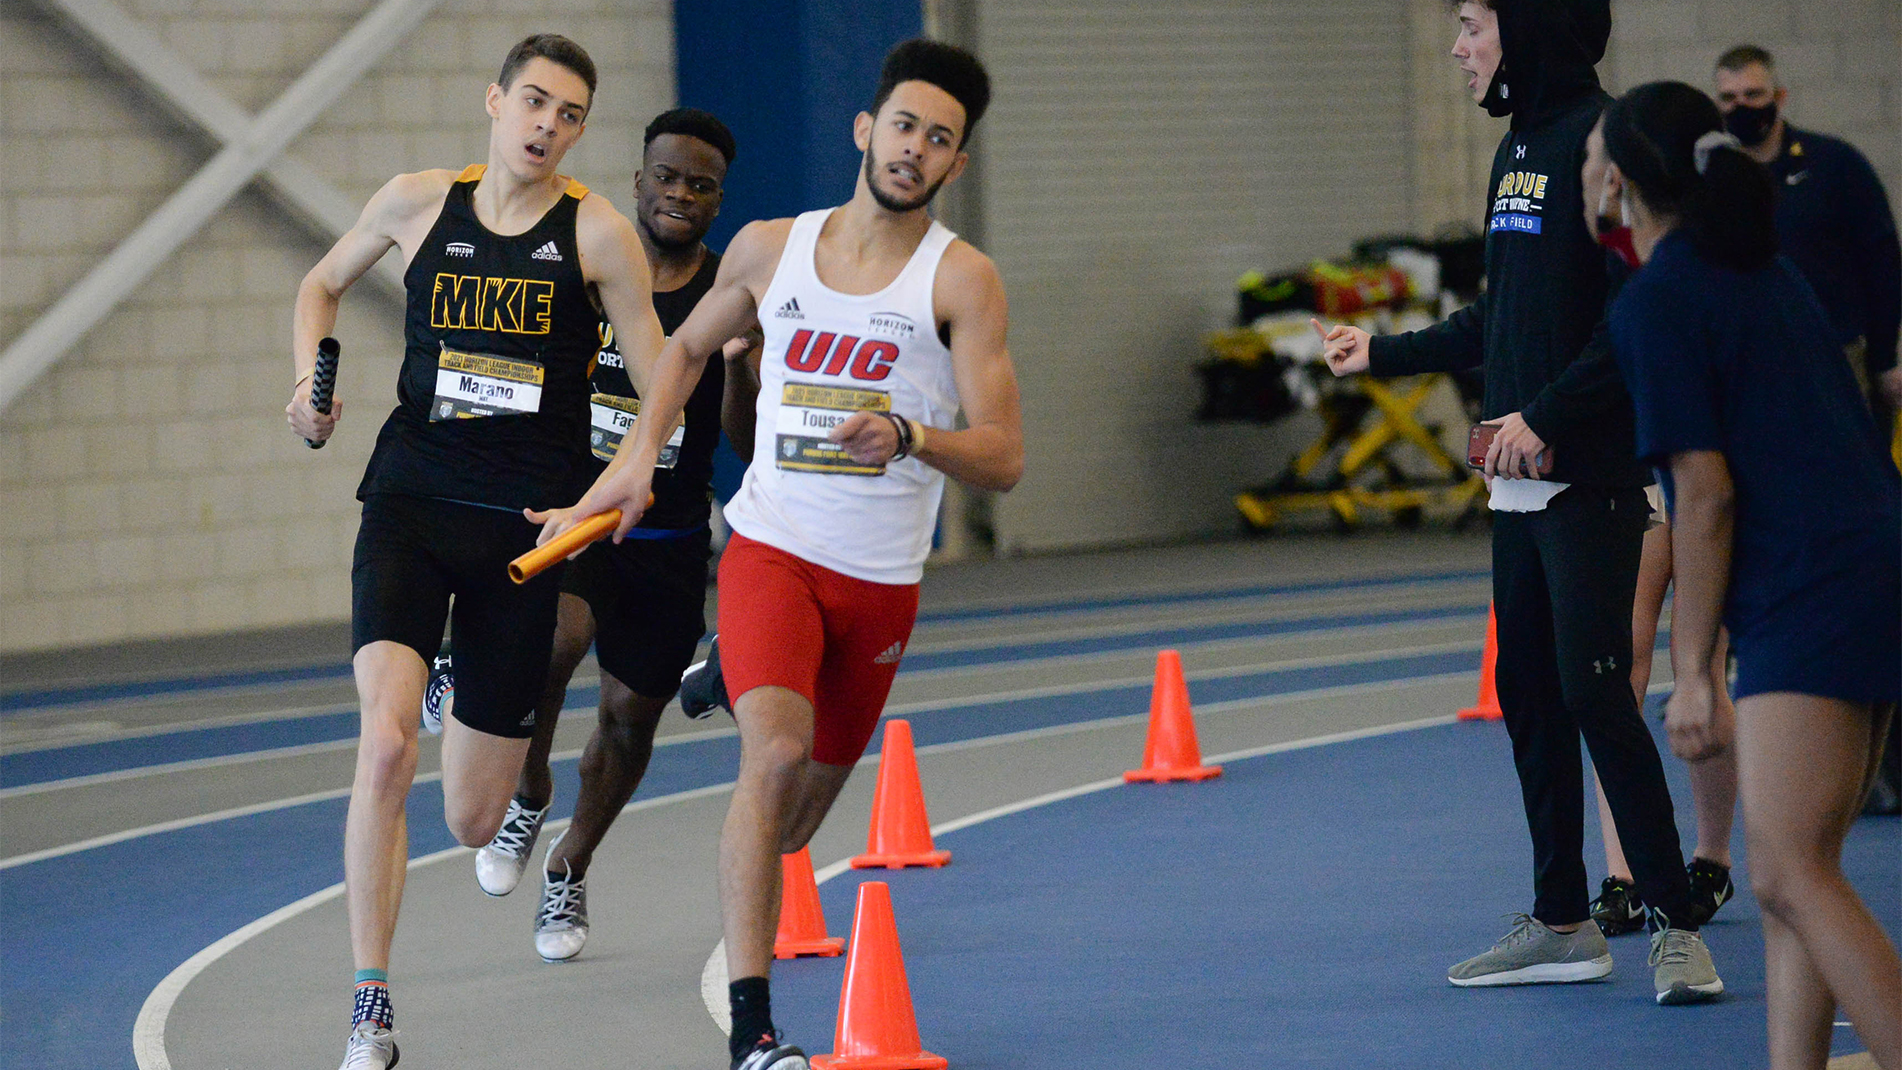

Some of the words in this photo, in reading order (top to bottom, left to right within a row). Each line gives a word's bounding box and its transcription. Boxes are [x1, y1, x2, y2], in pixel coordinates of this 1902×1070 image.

[1496, 171, 1549, 199] URDUE
[1510, 216, 1533, 230] FIELD
[446, 246, 475, 255] HORIZON
[531, 252, 563, 262] adidas
[431, 272, 555, 335] MKE
[774, 310, 805, 320] adidas
[869, 317, 914, 333] HORIZON
[597, 352, 625, 369] ORT
[783, 328, 900, 382] UIC
[444, 359, 462, 369] TRACK
[474, 363, 489, 374] FIELD
[489, 367, 539, 382] CHAMPIONSHIPS
[489, 360, 511, 370] LEAGUE
[511, 363, 534, 374] INDOOR
[459, 376, 514, 400] Marano
[612, 411, 636, 430] Fag
[801, 409, 846, 429] Tousa
